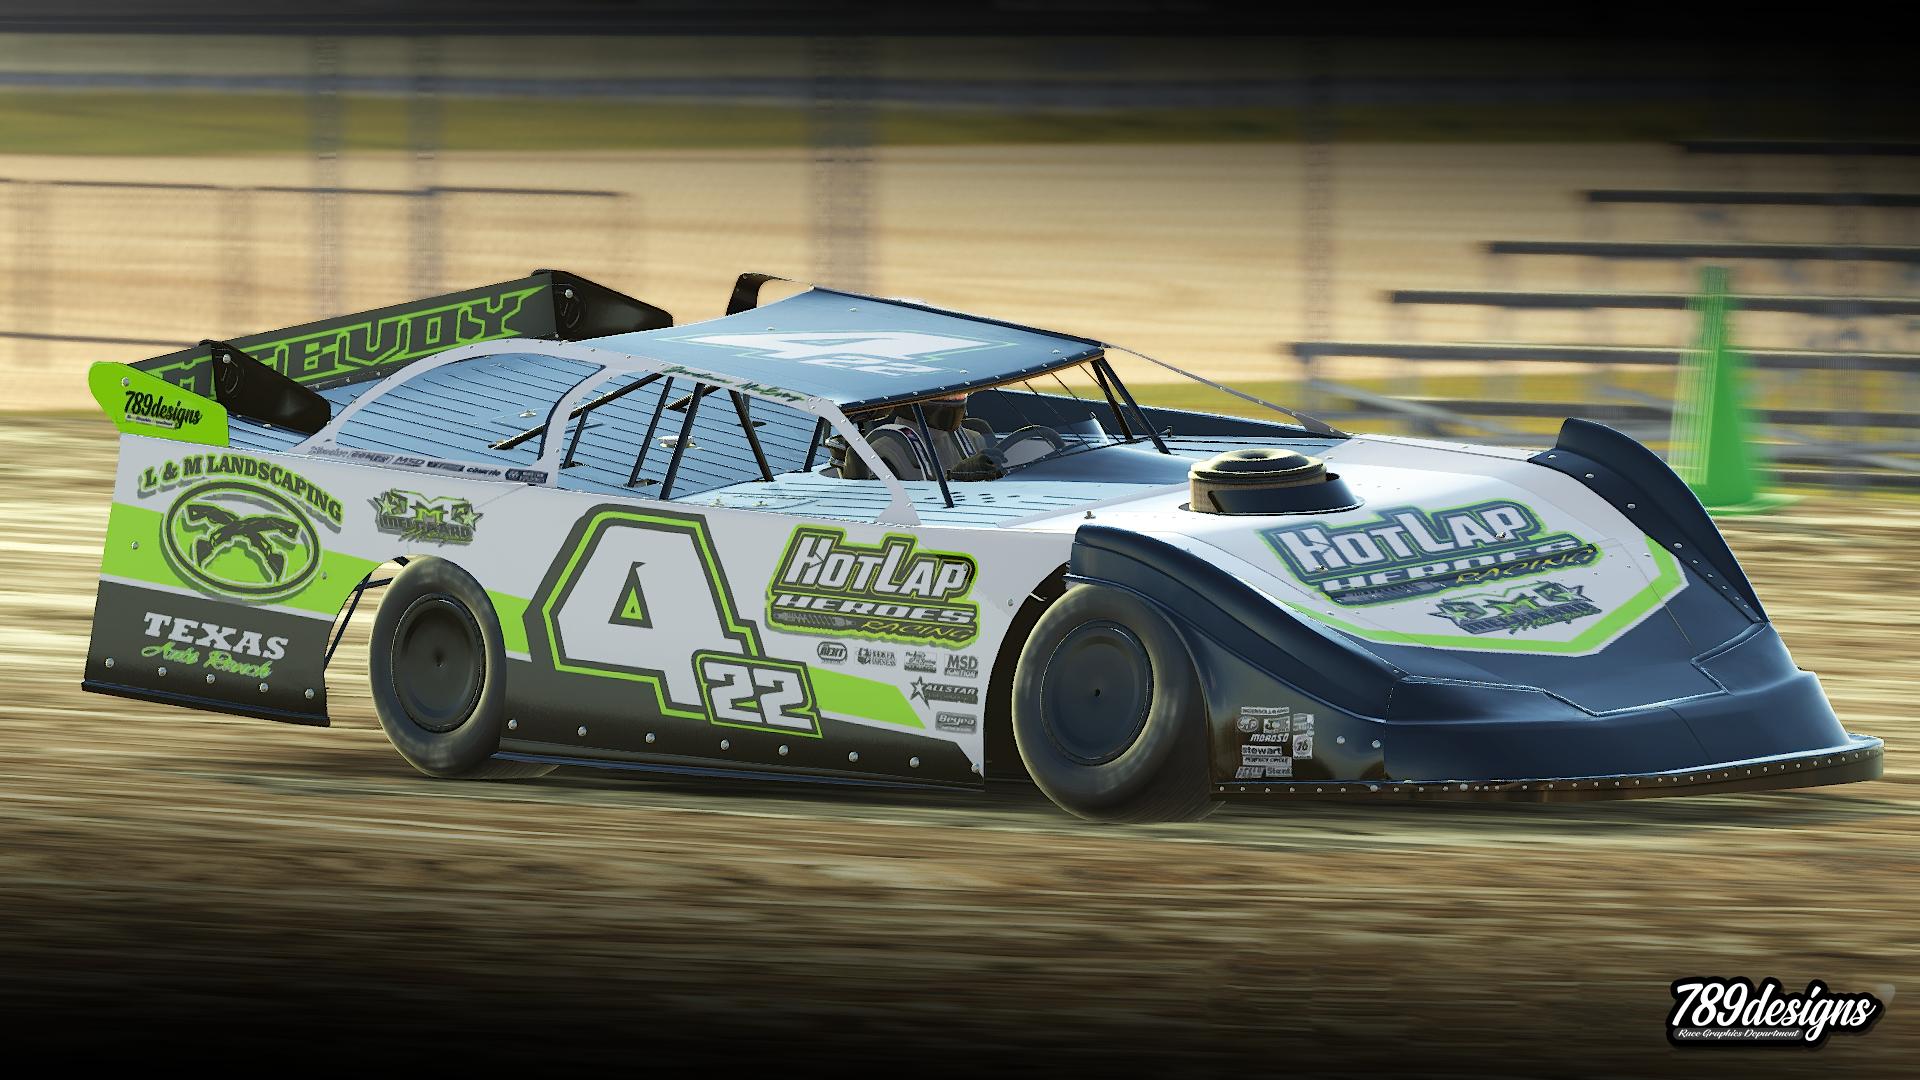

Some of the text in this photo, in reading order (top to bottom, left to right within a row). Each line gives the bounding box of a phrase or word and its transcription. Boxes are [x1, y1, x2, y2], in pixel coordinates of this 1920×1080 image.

[157, 284, 548, 400] MEVOY
[124, 390, 203, 430] 789designs
[143, 466, 158, 489] L
[162, 461, 178, 481] &
[182, 456, 201, 477] M
[206, 455, 343, 523] LANDSCAPING
[548, 516, 754, 712] 4
[775, 594, 976, 624] HEROES
[861, 620, 974, 640] RACING
[143, 611, 289, 661] TEXAS
[948, 653, 979, 670] MSD
[699, 658, 818, 733] 22
[925, 683, 976, 696] ALLSTAR
